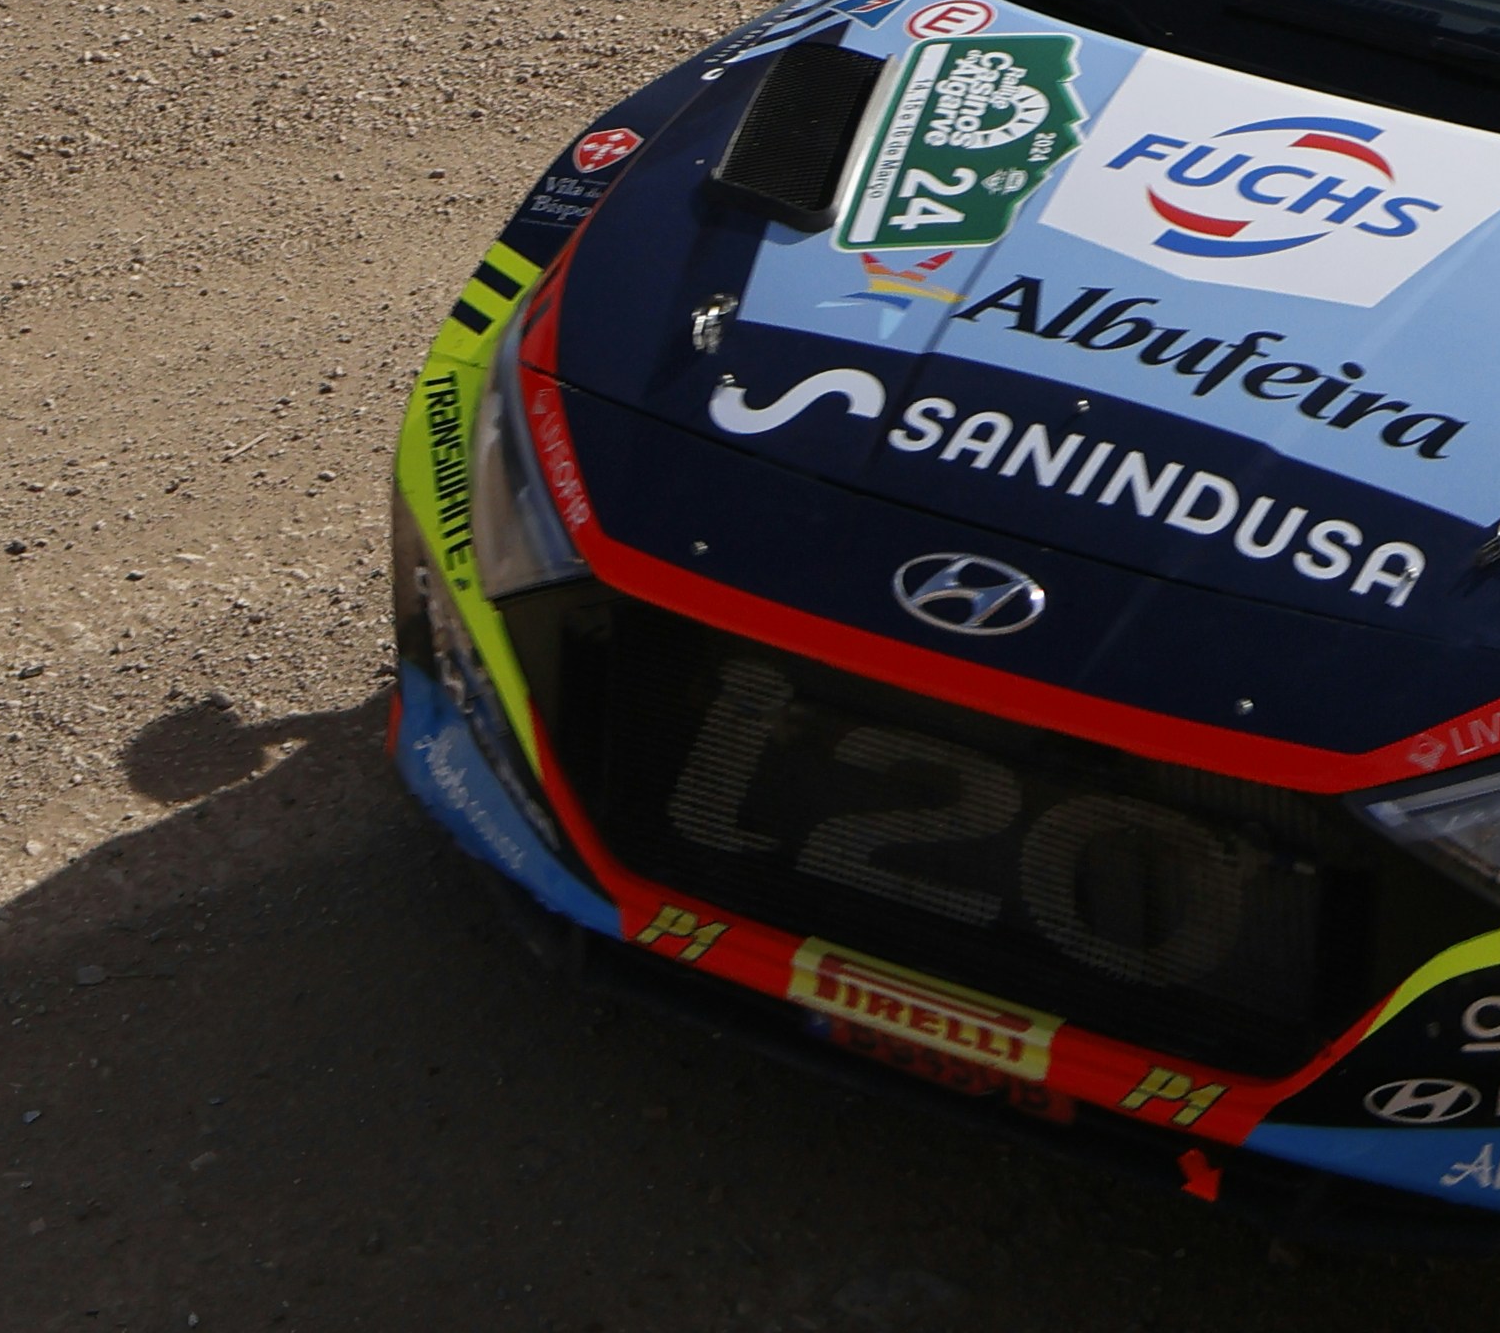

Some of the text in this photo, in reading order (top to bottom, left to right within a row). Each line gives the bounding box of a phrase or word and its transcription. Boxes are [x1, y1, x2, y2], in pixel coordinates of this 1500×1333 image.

[923, 7, 978, 31] E
[924, 57, 980, 146] Algarve
[950, 52, 1014, 149] Casinos
[867, 159, 902, 200] Março
[1028, 133, 1057, 162] 2024
[546, 176, 585, 196] Vila
[889, 167, 978, 231] 24
[1105, 133, 1443, 238] FUCHS
[950, 274, 1470, 461] Albufeira
[887, 397, 1427, 608] SANINDUSA
[635, 904, 729, 962] P1
[815, 951, 1044, 1063] PIRELLI
[1119, 1066, 1229, 1126] P1
